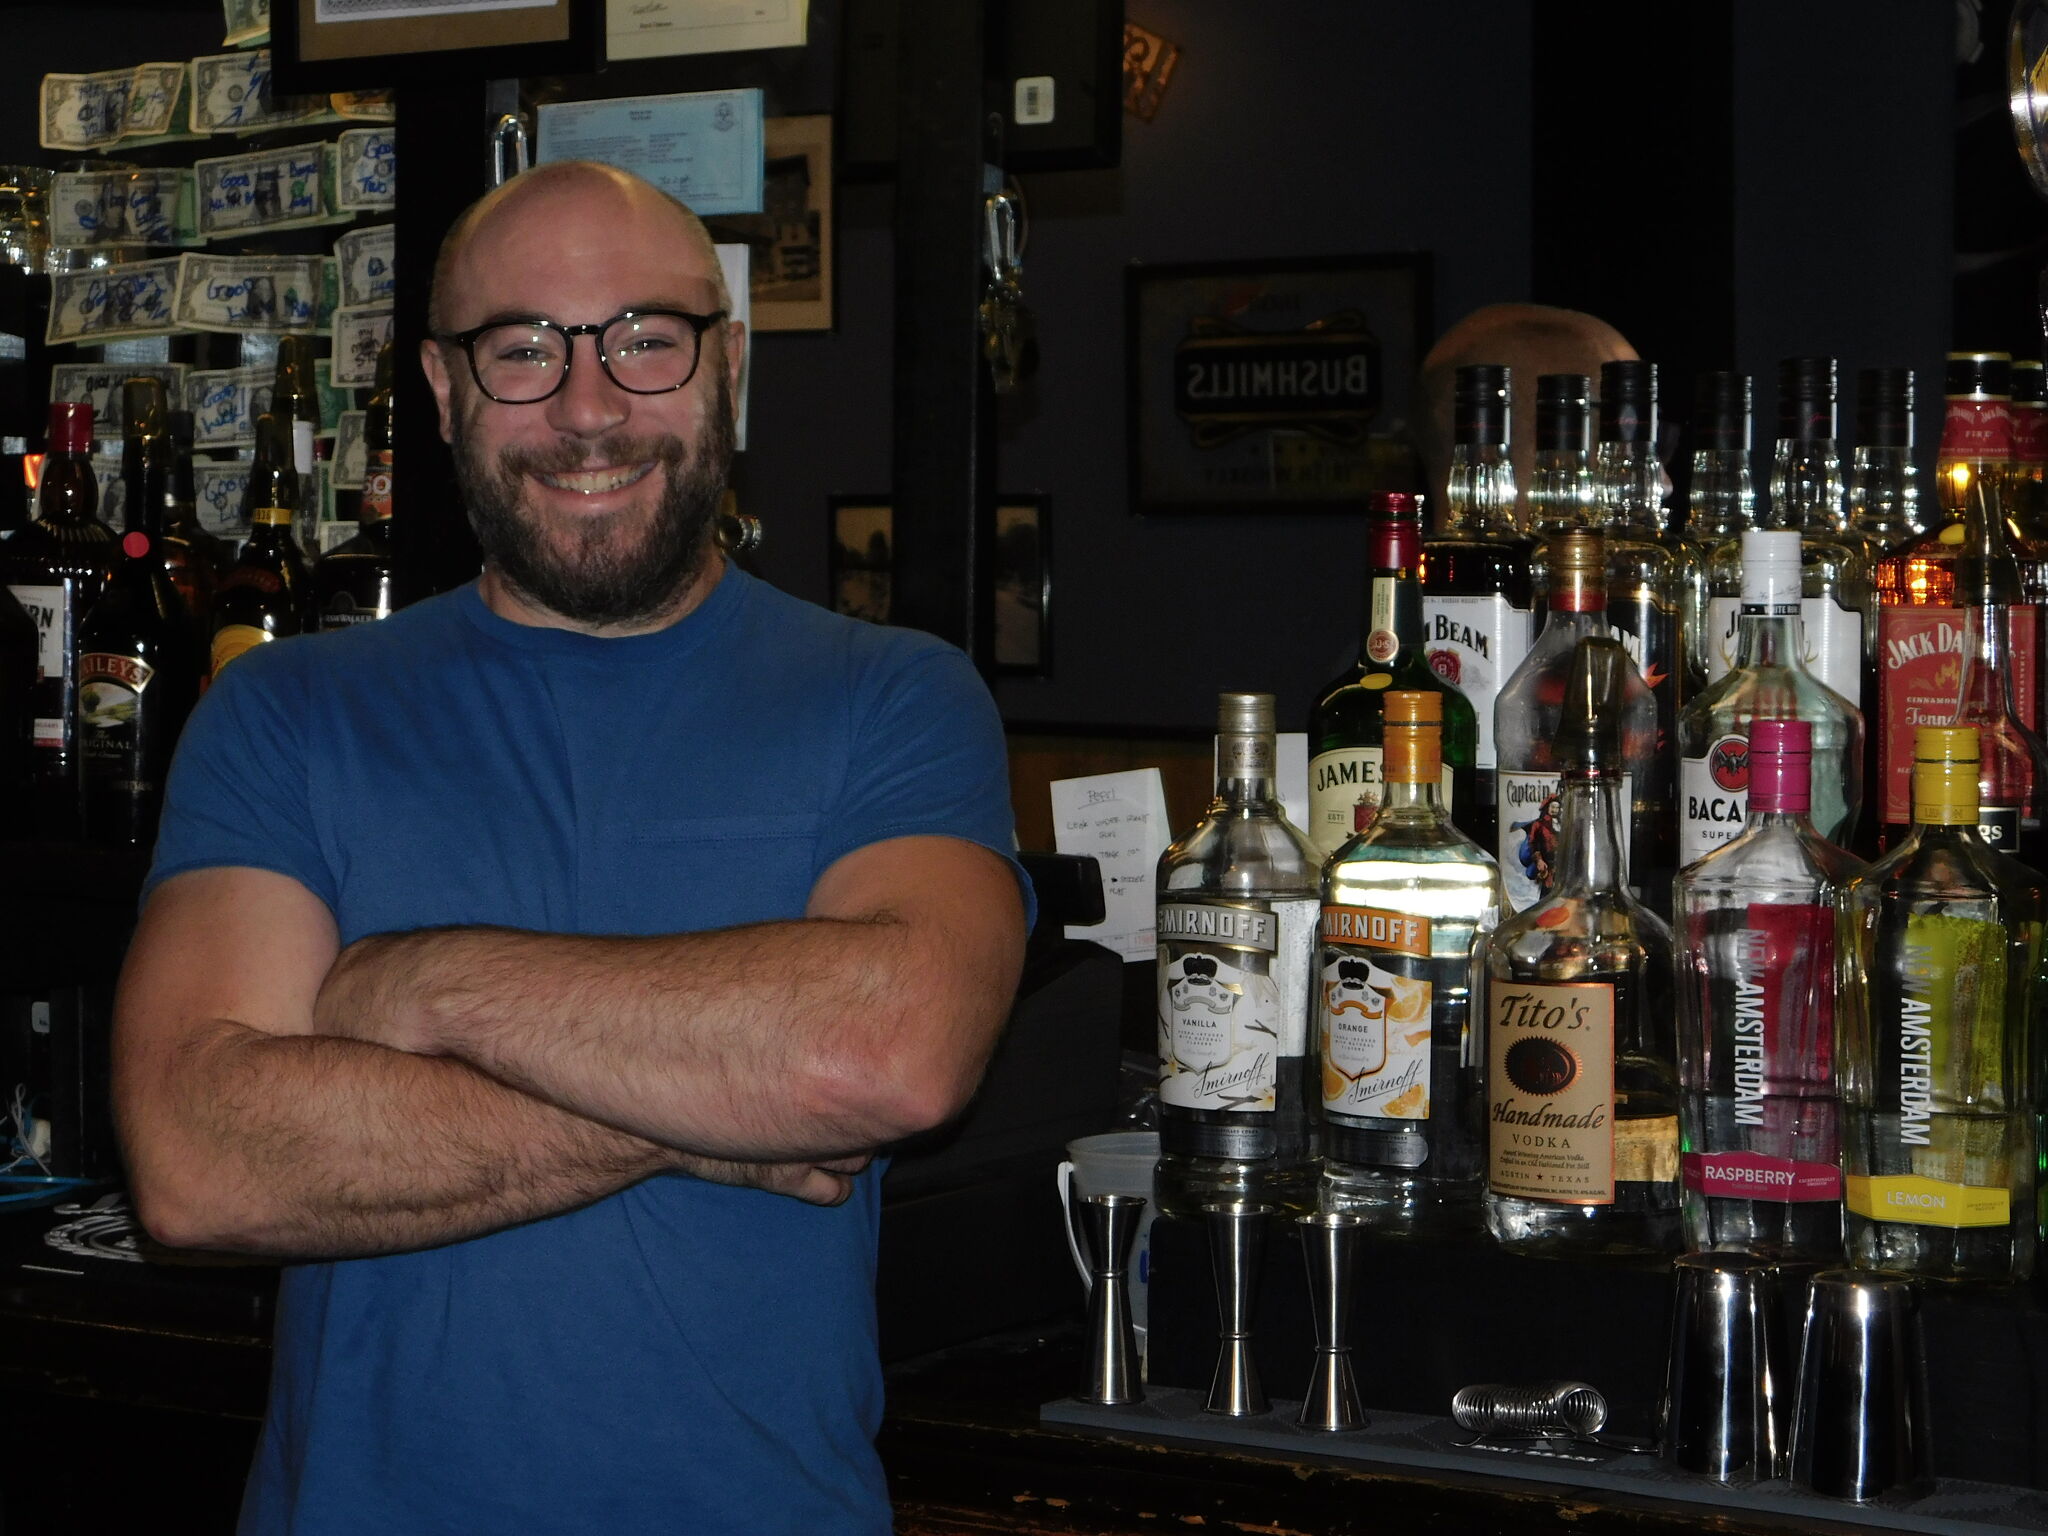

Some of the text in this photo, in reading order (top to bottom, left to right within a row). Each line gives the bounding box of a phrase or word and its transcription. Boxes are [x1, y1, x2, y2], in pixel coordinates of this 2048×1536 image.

[1435, 614, 1489, 660] BEAM
[1887, 632, 1935, 670] JACK
[1689, 796, 1748, 823] BACA
[1702, 830, 1739, 841] SUPE
[1322, 912, 1420, 947] MIRNOFF
[1182, 1019, 1217, 1028] VANILLA
[1499, 993, 1591, 1030] Tito's
[1338, 1022, 1368, 1033] ORANGE
[1734, 979, 1765, 1127] AMSTERDAM
[1194, 1052, 1270, 1098] Smirnoff
[1348, 1058, 1423, 1105] Smirnoff
[1900, 997, 1933, 1146] AMSTERDAM
[1493, 1098, 1605, 1129] Handmade
[1512, 1133, 1571, 1149] VODKA
[1552, 1175, 1590, 1184] TEXAS
[1705, 1165, 1796, 1186] RASPBERRY
[1887, 1191, 1946, 1209] LEMON
